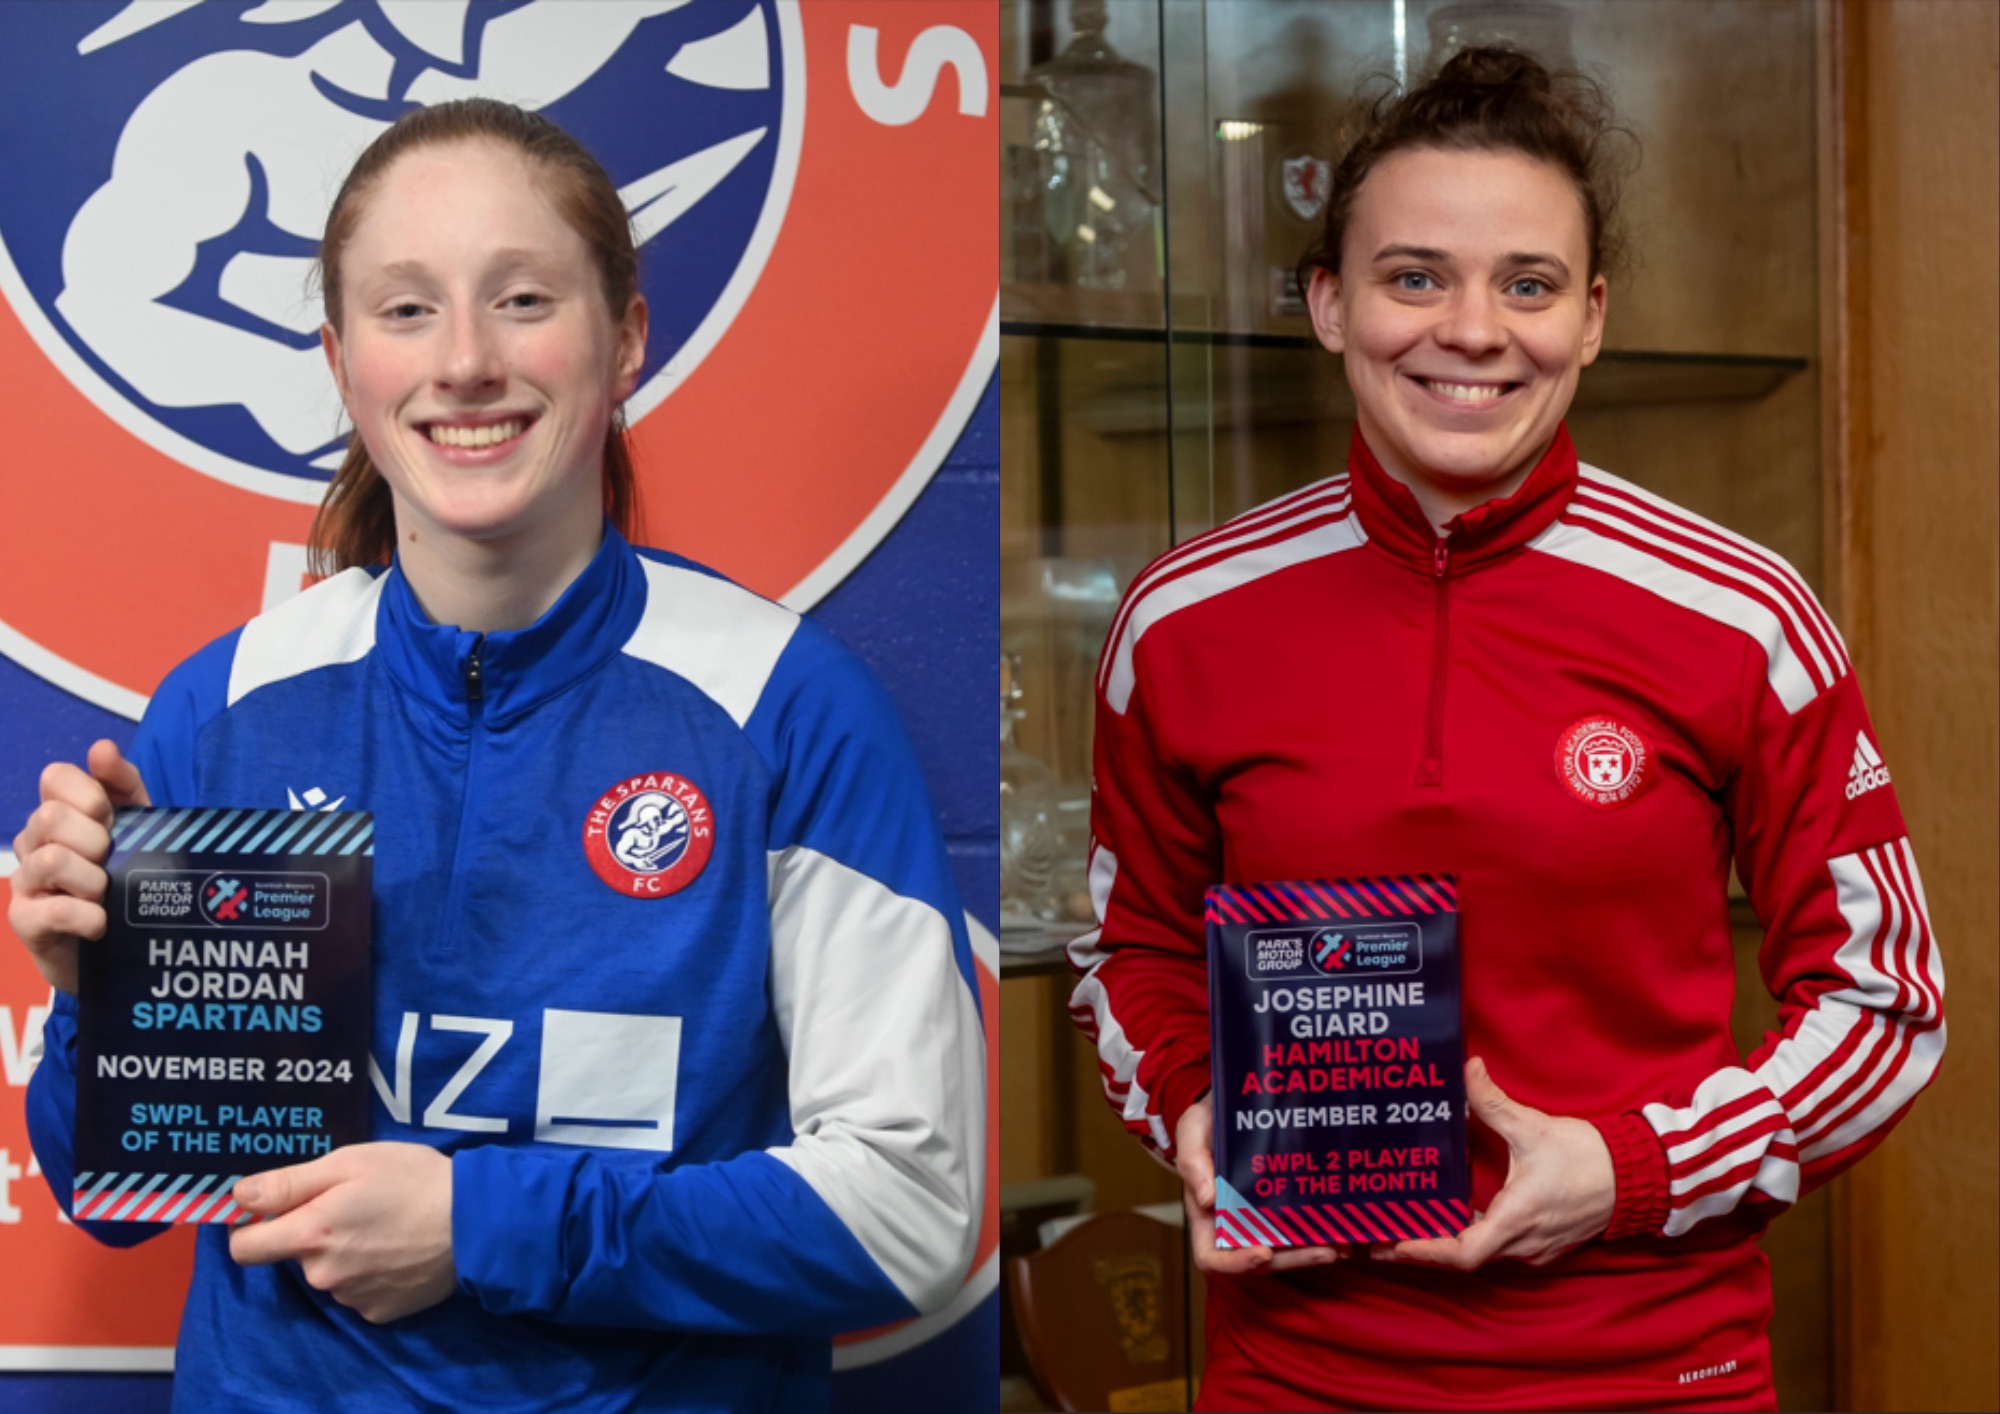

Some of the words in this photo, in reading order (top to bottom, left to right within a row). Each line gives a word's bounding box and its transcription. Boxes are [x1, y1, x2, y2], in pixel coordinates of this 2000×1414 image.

[588, 798, 616, 837] THE
[616, 776, 710, 837] SPARTANS
[139, 880, 193, 893] PARK'S
[254, 890, 315, 904] Premier
[633, 877, 661, 892] FC
[138, 904, 191, 916] GROUP
[139, 893, 193, 905] MOTOR
[254, 905, 310, 922] League
[149, 939, 308, 969] HANNAH
[1257, 938, 1302, 950] PARK'S
[1257, 949, 1303, 961] MOTOR
[1356, 939, 1409, 953] Premier
[1257, 959, 1303, 971] GROUP
[1356, 954, 1406, 968] League
[151, 971, 304, 1000] JORDAN
[1254, 982, 1425, 1013] JOSEPHINE
[132, 1001, 323, 1032] SPARTANS
[1290, 1011, 1390, 1038] GIARD
[1263, 1036, 1419, 1067] HAMILTON
[97, 1055, 265, 1082] NOVEMBER
[275, 1059, 353, 1083] 2024
[1241, 1063, 1444, 1095] ACADEMICAL
[130, 1103, 209, 1125] SWPL
[218, 1106, 323, 1128] PLAYER
[1236, 1104, 1377, 1131] NOVEMBER
[1386, 1101, 1451, 1123] 2024
[121, 1130, 159, 1152] OF
[168, 1132, 221, 1153] THE
[230, 1133, 331, 1155] MONTH
[1251, 1153, 1318, 1173] SWPL
[1326, 1151, 1340, 1170] 2
[1348, 1147, 1439, 1169] PLAYER
[1254, 1178, 1287, 1197] OF
[1295, 1175, 1341, 1195] THE
[1349, 1171, 1437, 1193] MONTH
